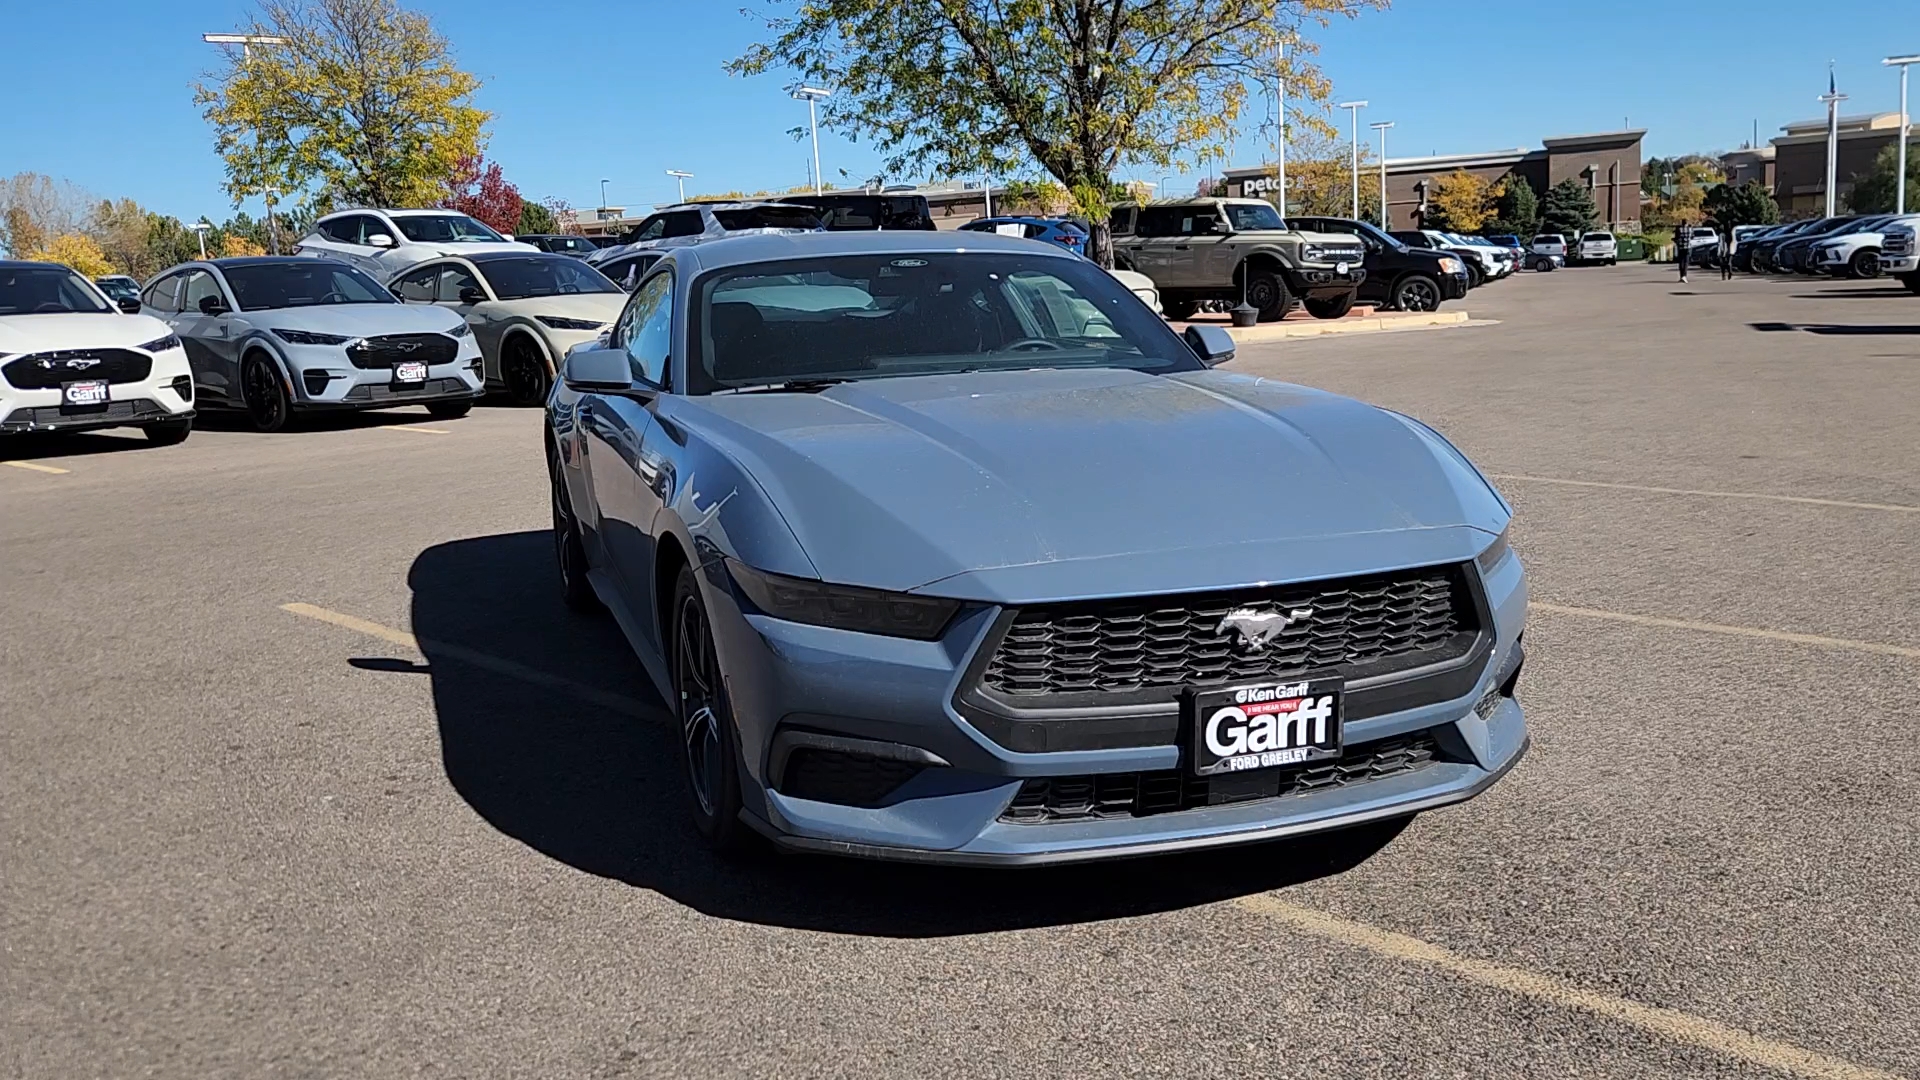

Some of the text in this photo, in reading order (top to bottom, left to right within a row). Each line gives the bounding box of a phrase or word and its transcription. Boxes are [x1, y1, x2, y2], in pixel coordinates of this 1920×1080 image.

[1243, 176, 1294, 196] petco
[397, 365, 427, 380] Garff
[66, 385, 106, 401] Garff
[1248, 682, 1309, 702] Ken Garff
[1205, 695, 1333, 757] Garff
[1230, 748, 1308, 771] FORD GREELEY
